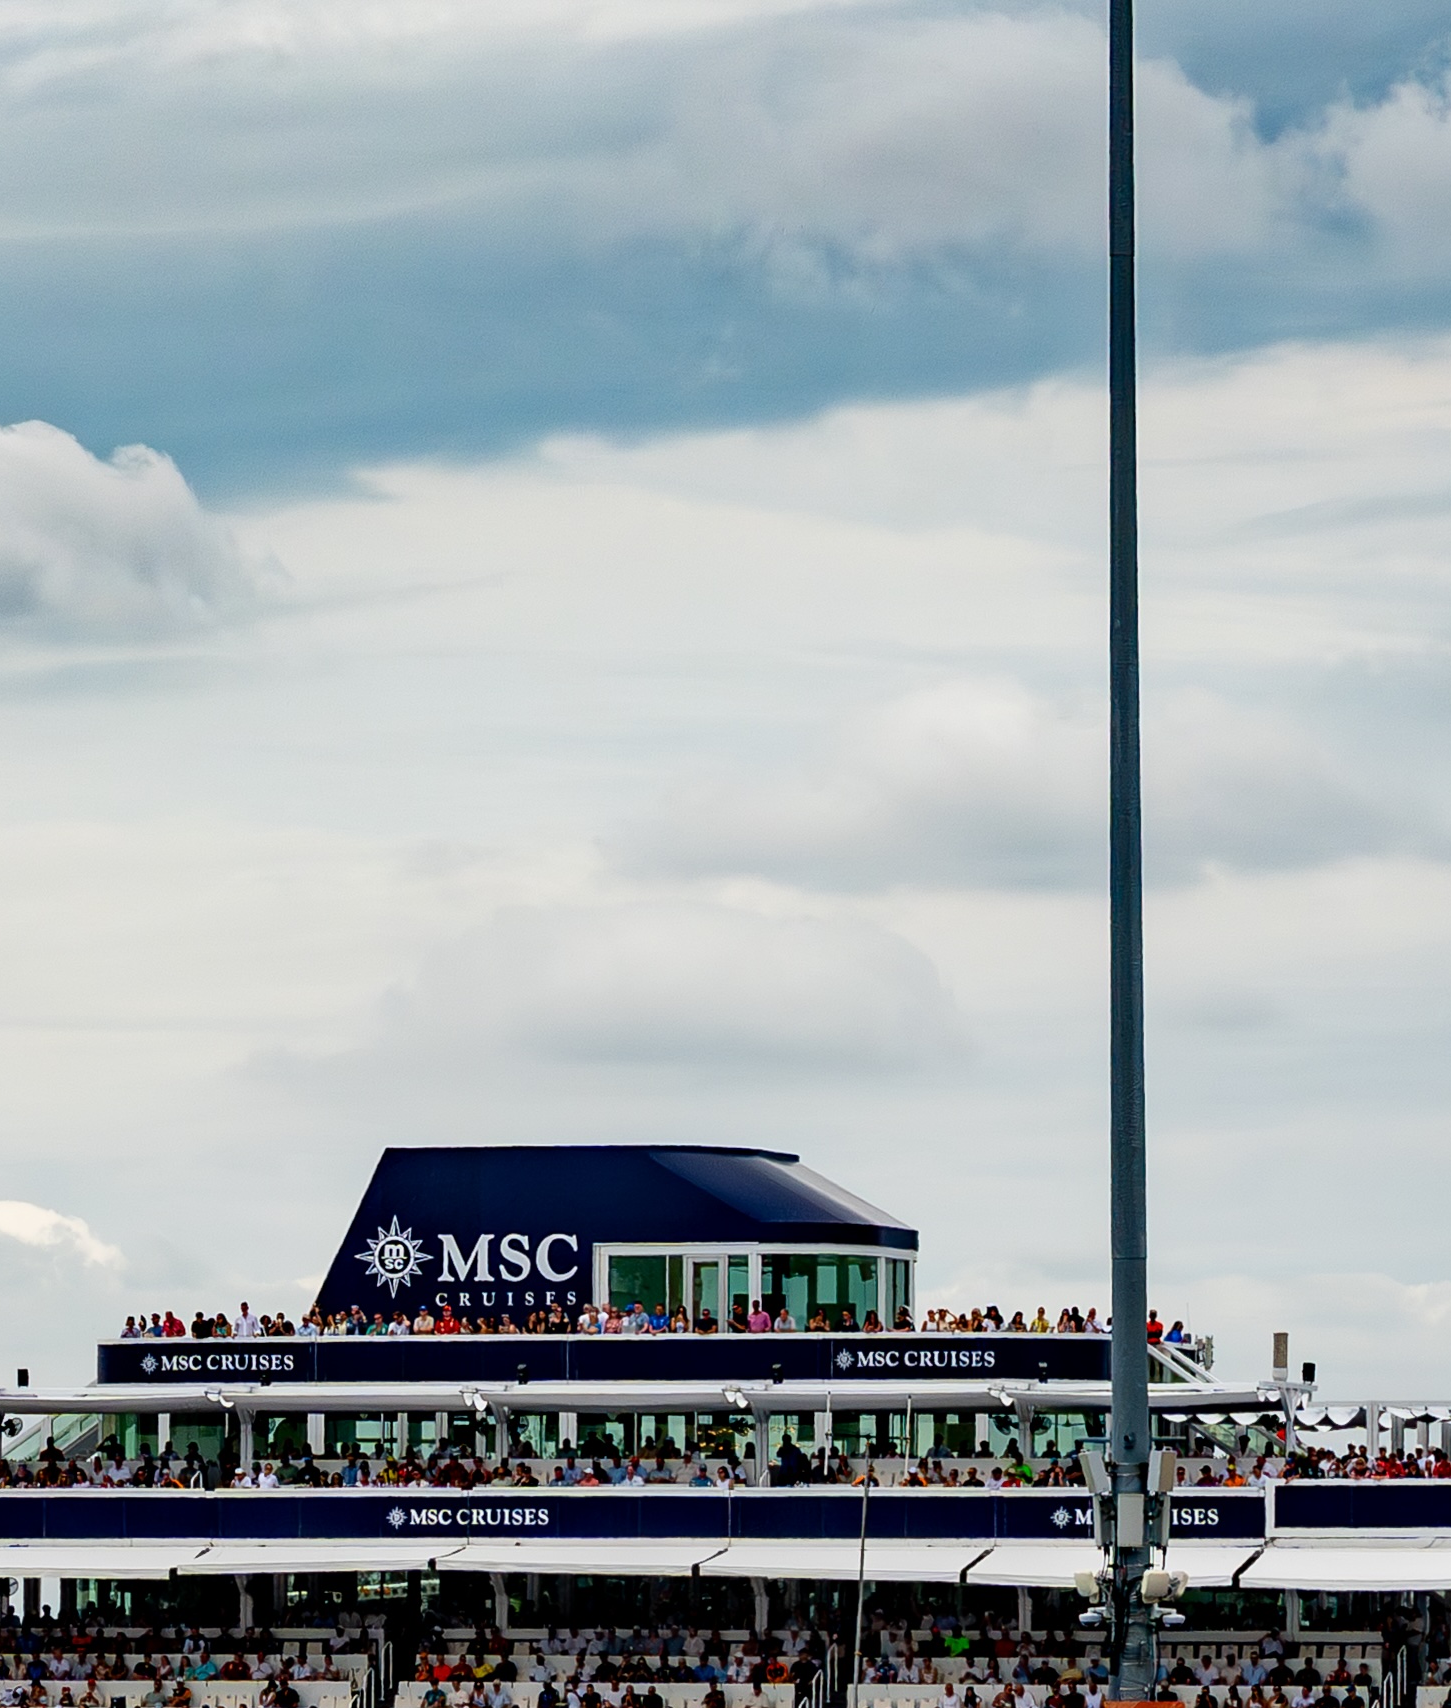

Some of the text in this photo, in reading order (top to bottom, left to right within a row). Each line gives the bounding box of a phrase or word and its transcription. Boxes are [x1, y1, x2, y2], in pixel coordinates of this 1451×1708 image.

[437, 1233, 579, 1282] MSC
[435, 1291, 577, 1307] CRUISES
[161, 1354, 294, 1371] MSC CRUISES
[858, 1351, 996, 1368] MSC CRUISES
[409, 1509, 549, 1526] MSC CRUISES
[1171, 1508, 1220, 1526] ISES
